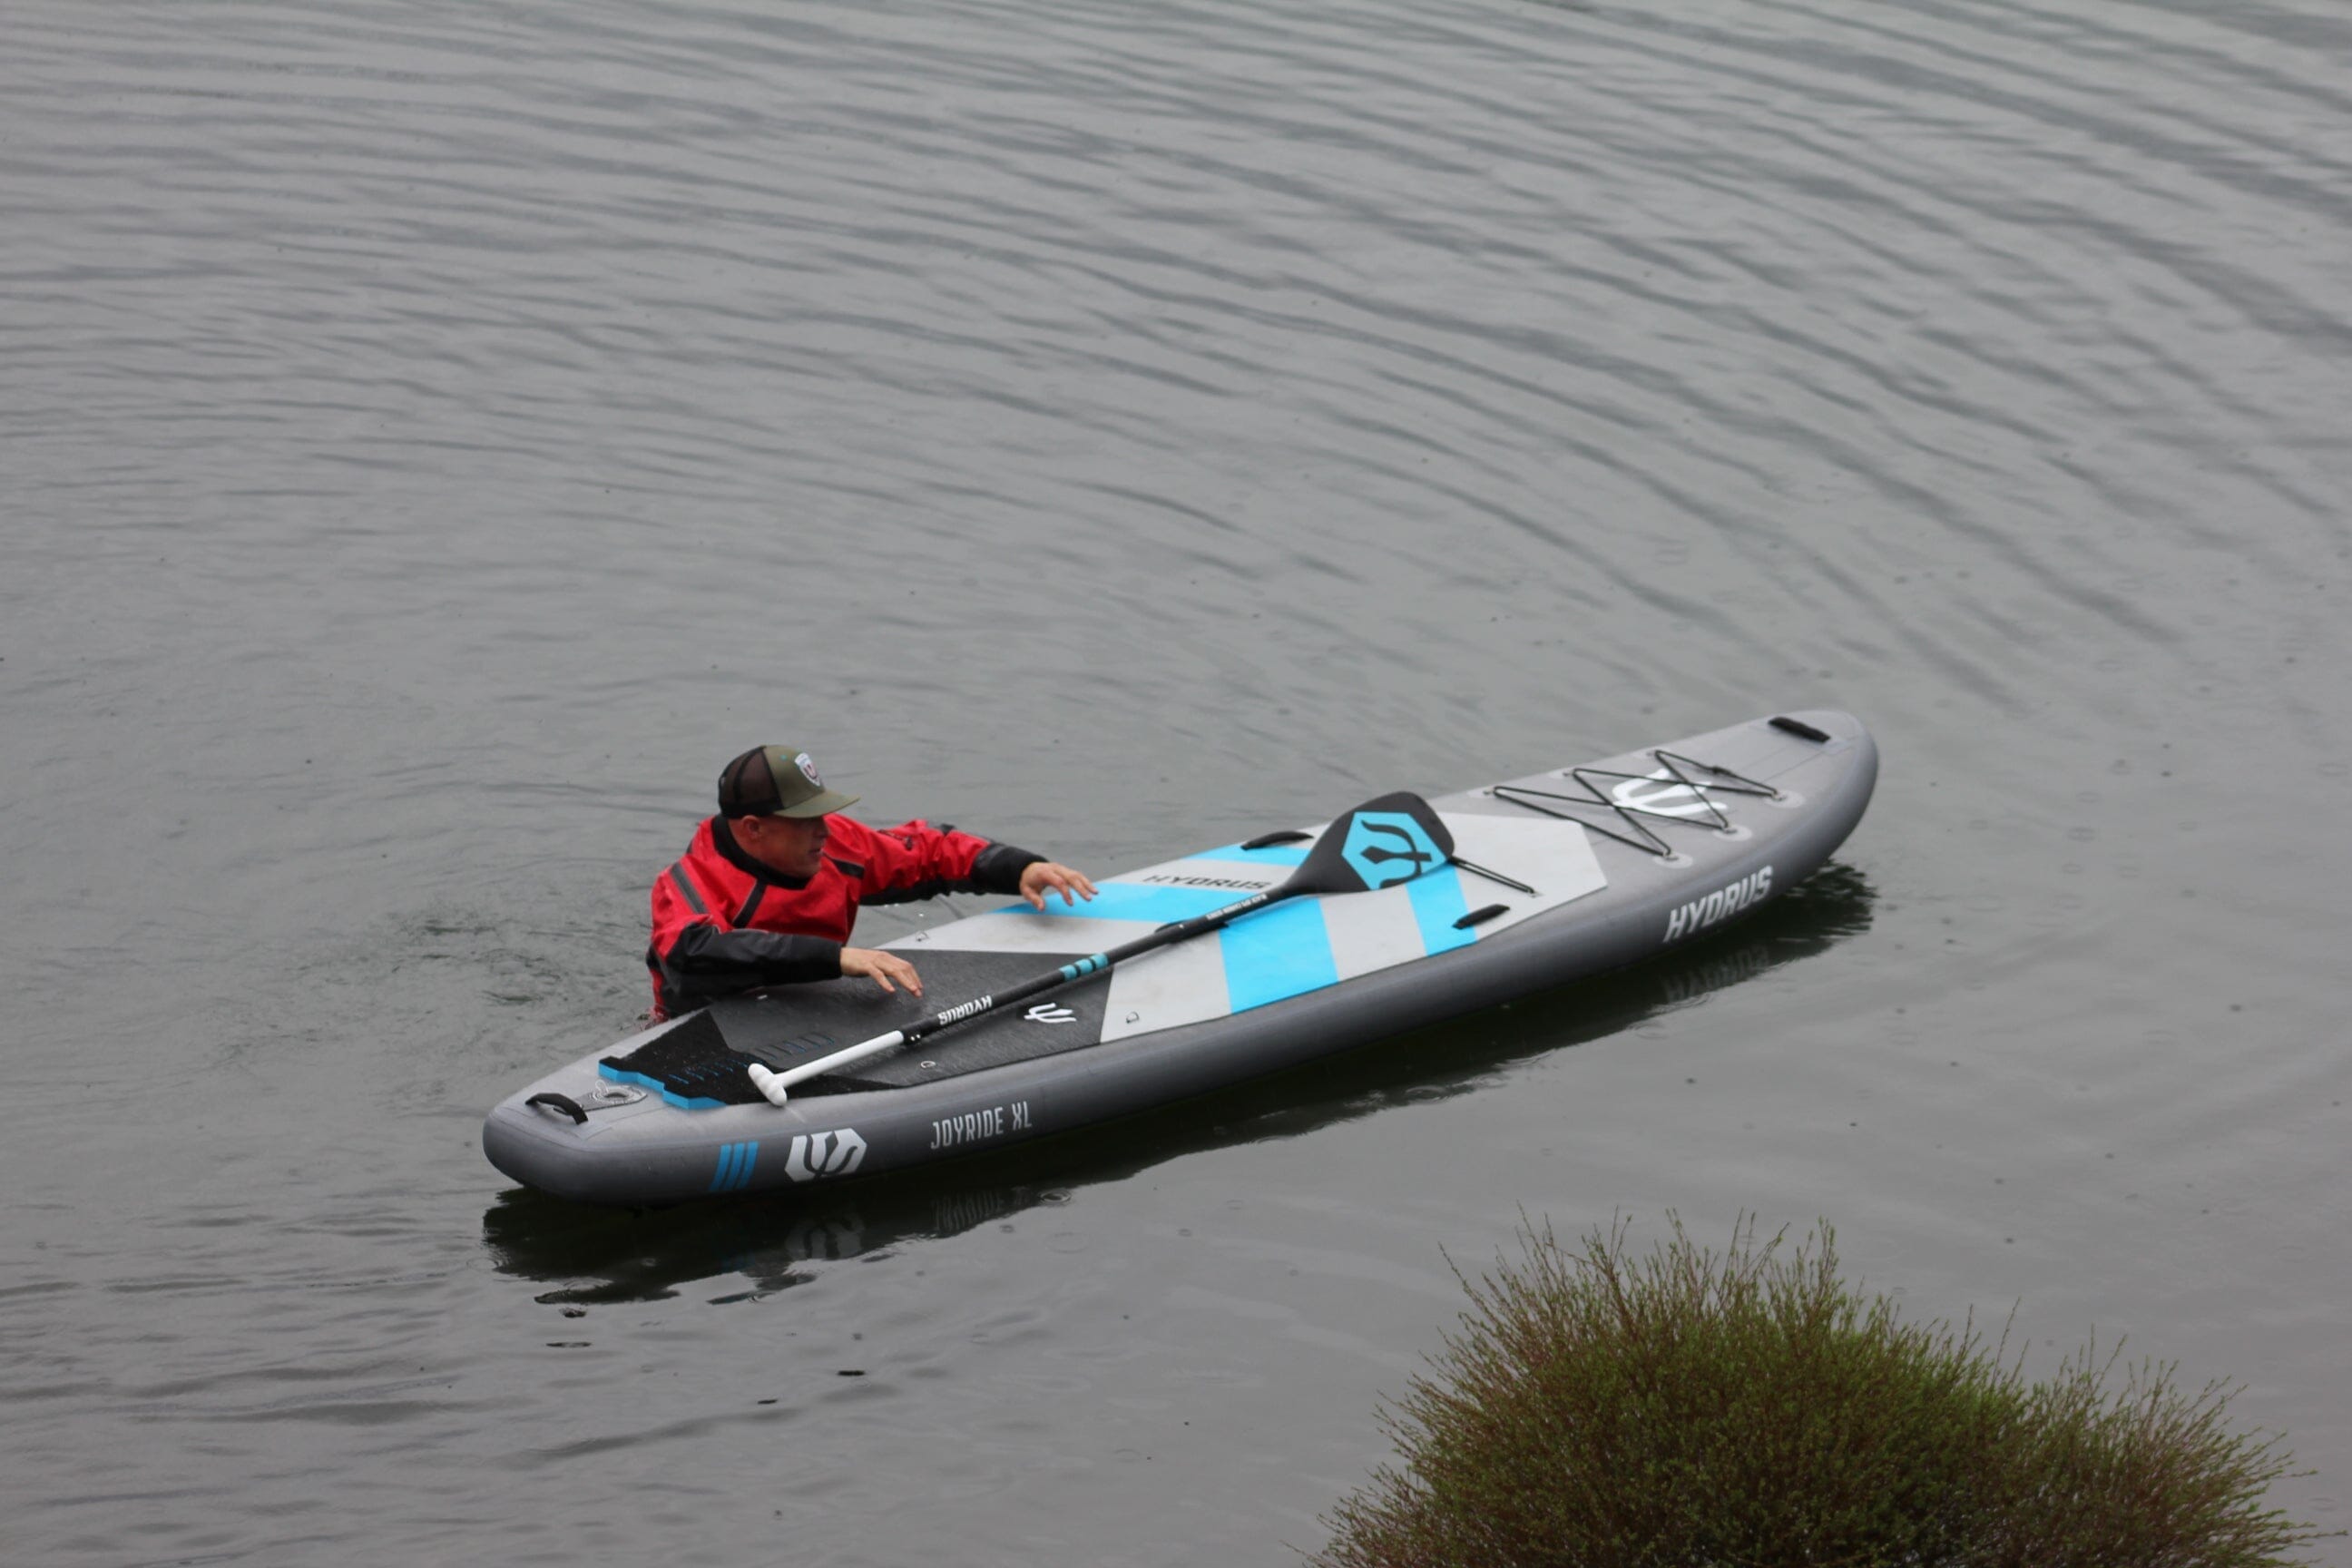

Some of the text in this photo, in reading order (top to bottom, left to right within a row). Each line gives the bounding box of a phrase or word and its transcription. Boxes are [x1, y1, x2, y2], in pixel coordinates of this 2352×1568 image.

[1142, 874, 1272, 890] HYDRUS
[1662, 865, 1773, 943] HYDRUS
[937, 995, 992, 1025] HYDRUS
[930, 1100, 1033, 1150] JOYRIDE XL
